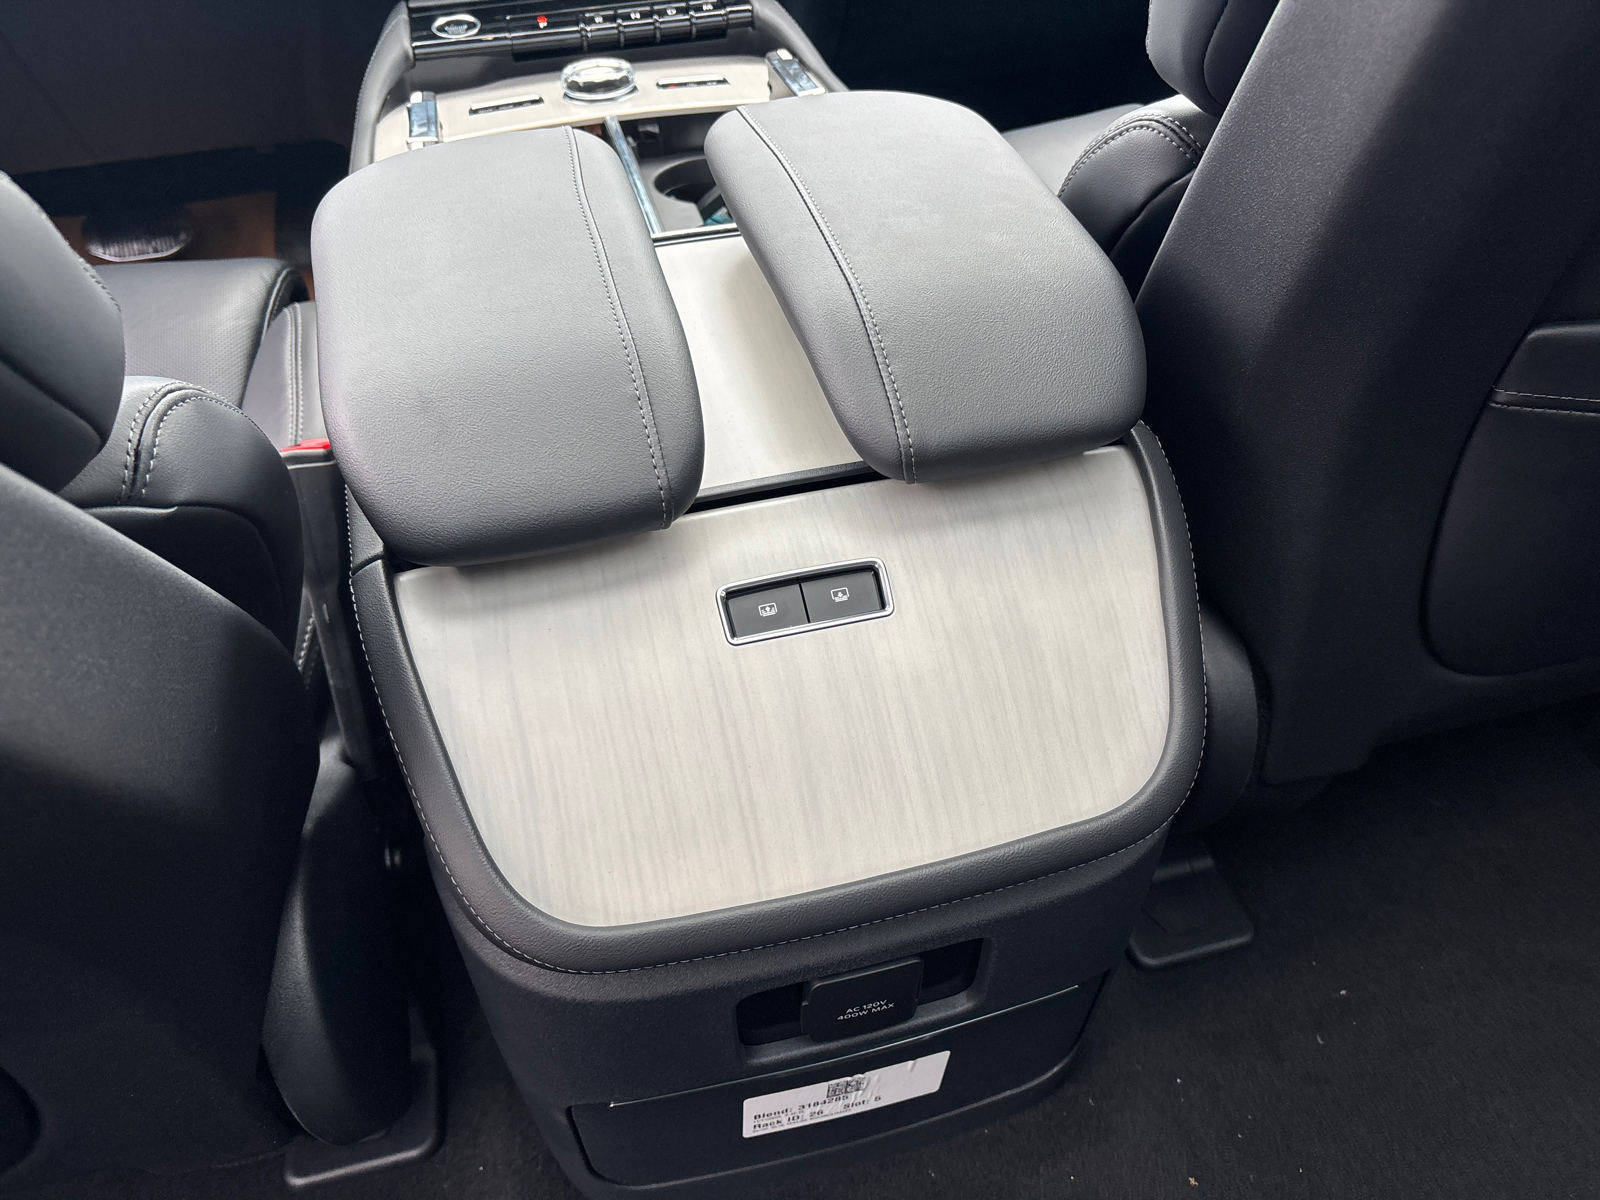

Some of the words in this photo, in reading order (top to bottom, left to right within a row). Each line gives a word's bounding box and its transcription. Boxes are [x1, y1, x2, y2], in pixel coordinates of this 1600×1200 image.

[862, 999, 888, 1009] 120V
[837, 1010, 869, 1020] 400W
[871, 1002, 895, 1013] MAX
[753, 1119, 782, 1129] Rack
